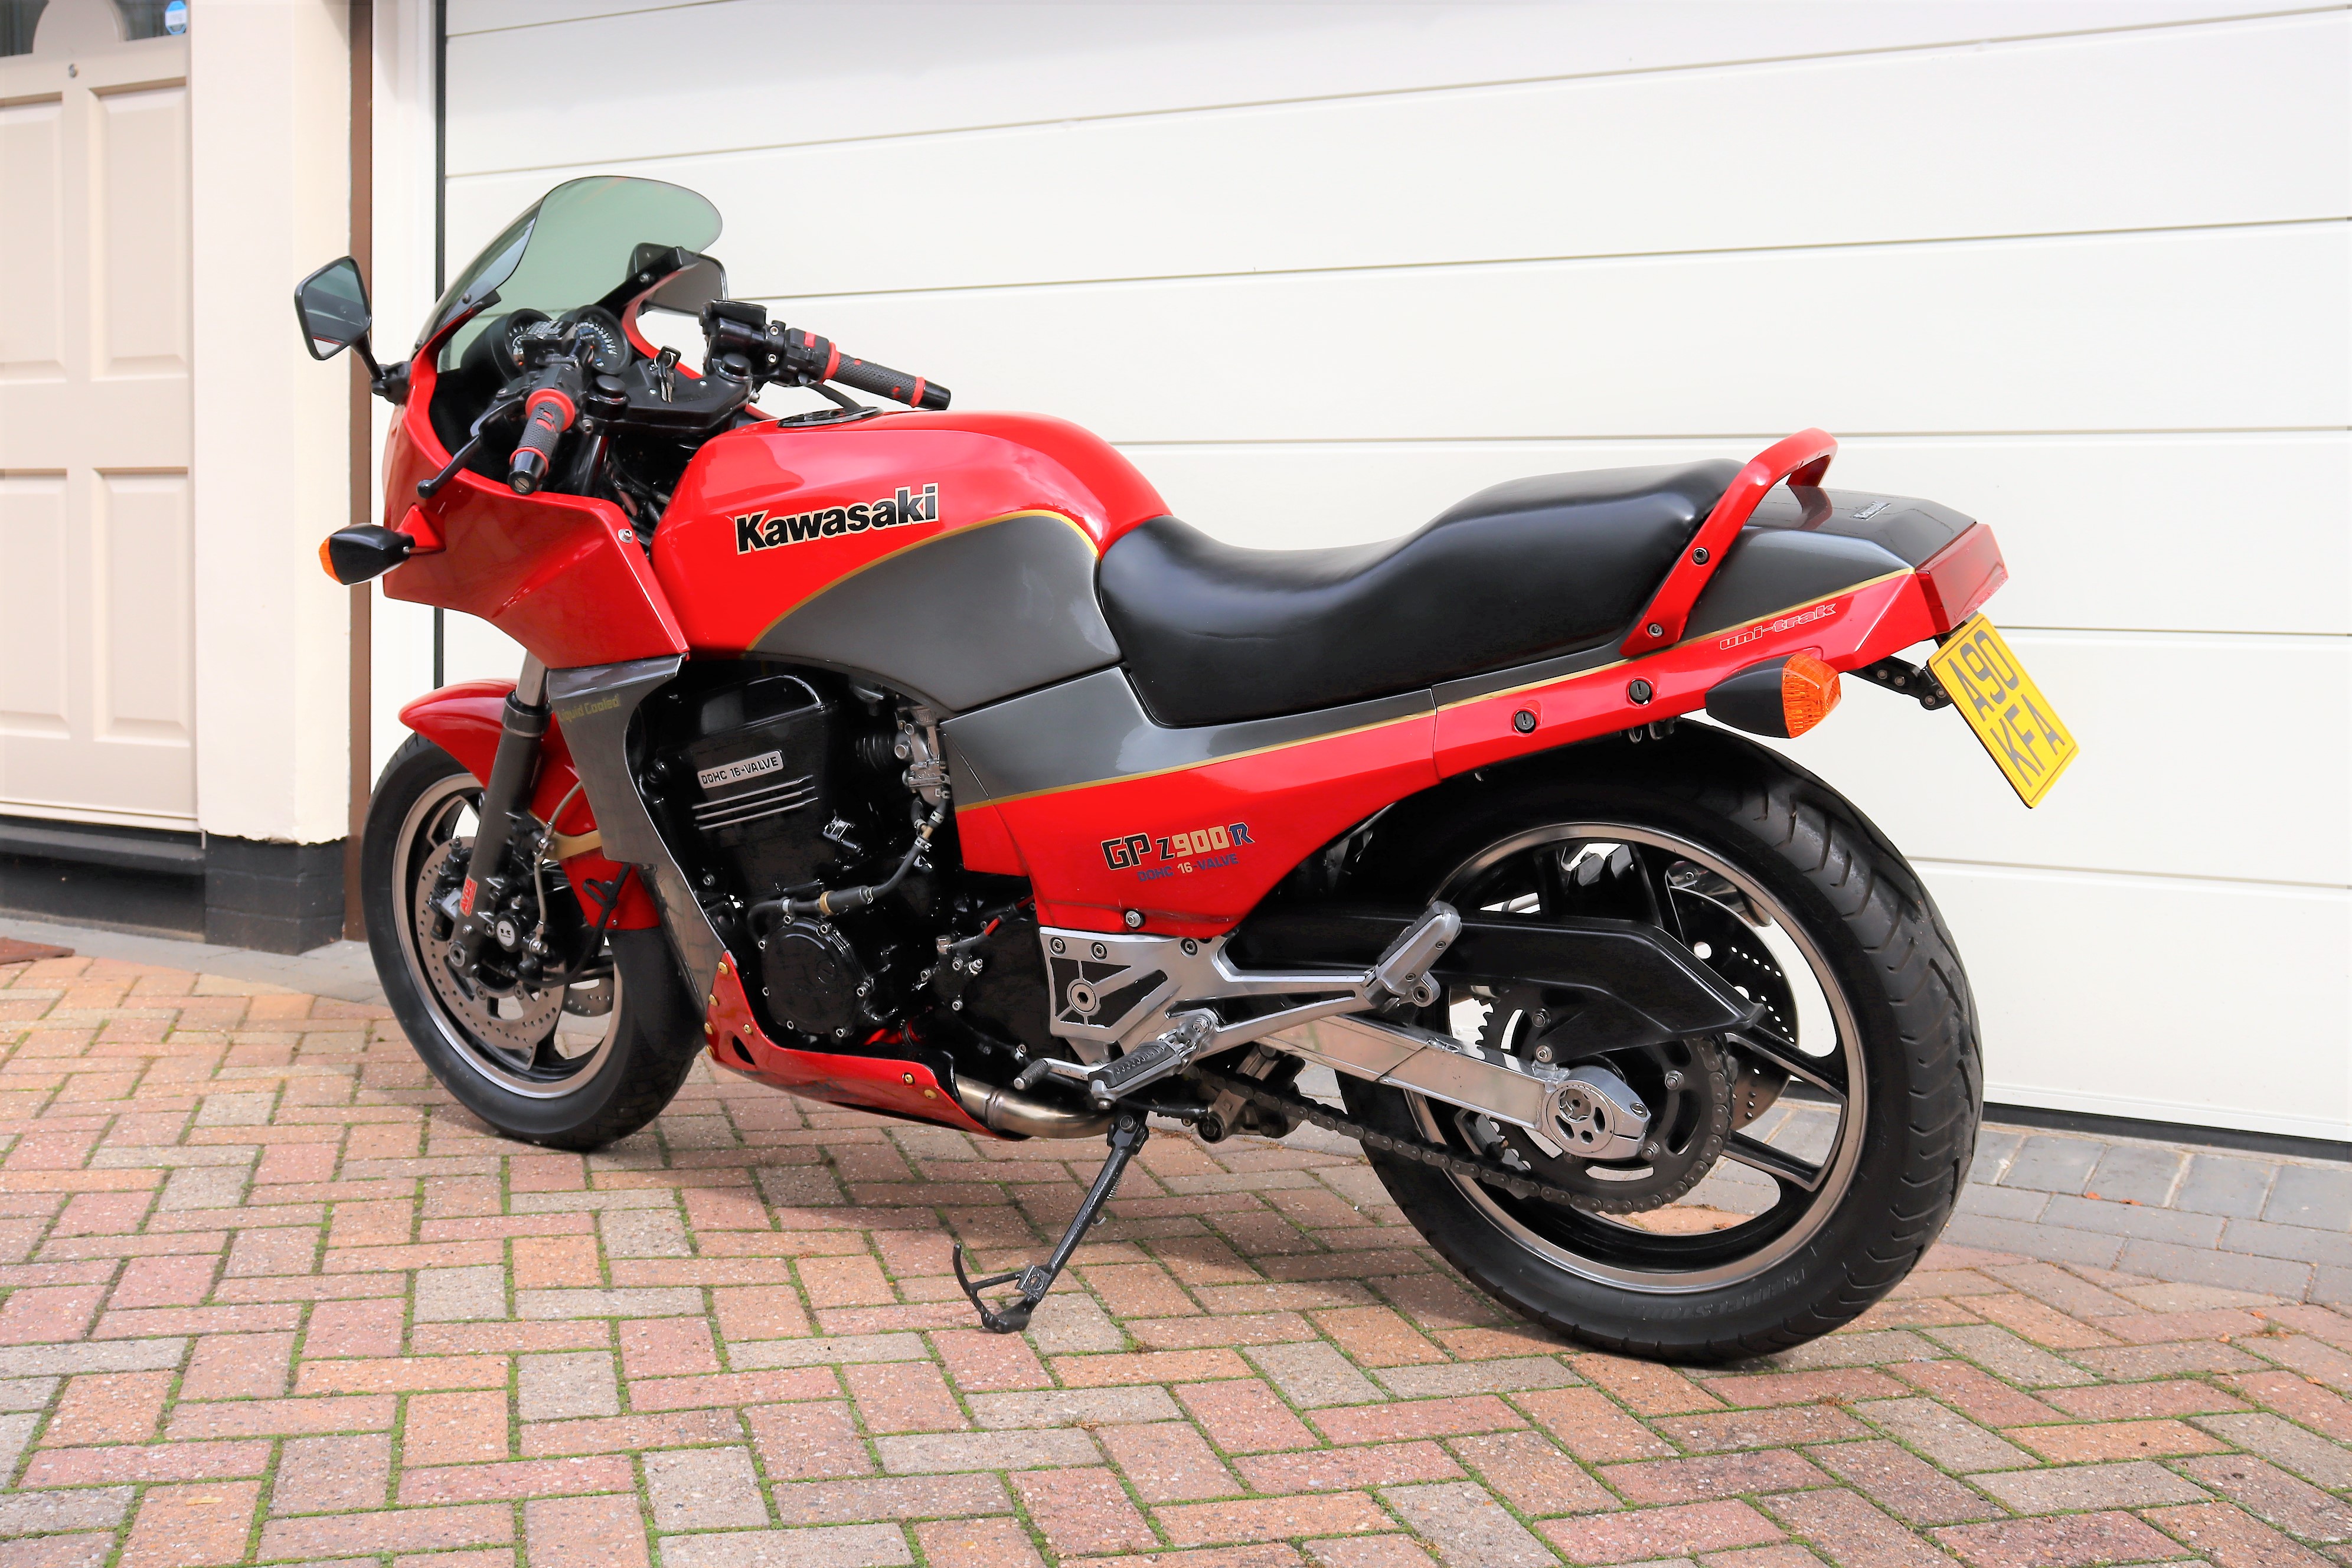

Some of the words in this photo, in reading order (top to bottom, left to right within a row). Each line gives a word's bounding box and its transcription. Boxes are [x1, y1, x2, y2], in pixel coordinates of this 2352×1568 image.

[734, 482, 939, 555] Kawasaki
[1720, 603, 1837, 650] uni-trak
[1948, 629, 2020, 722] A90
[584, 693, 620, 715] Cooled
[1990, 694, 2066, 788] KFA
[701, 770, 727, 785] DOHC
[730, 756, 779, 778] 16-VALVE
[1136, 866, 1174, 882] DOHC
[1177, 853, 1239, 874] 16-VALVE
